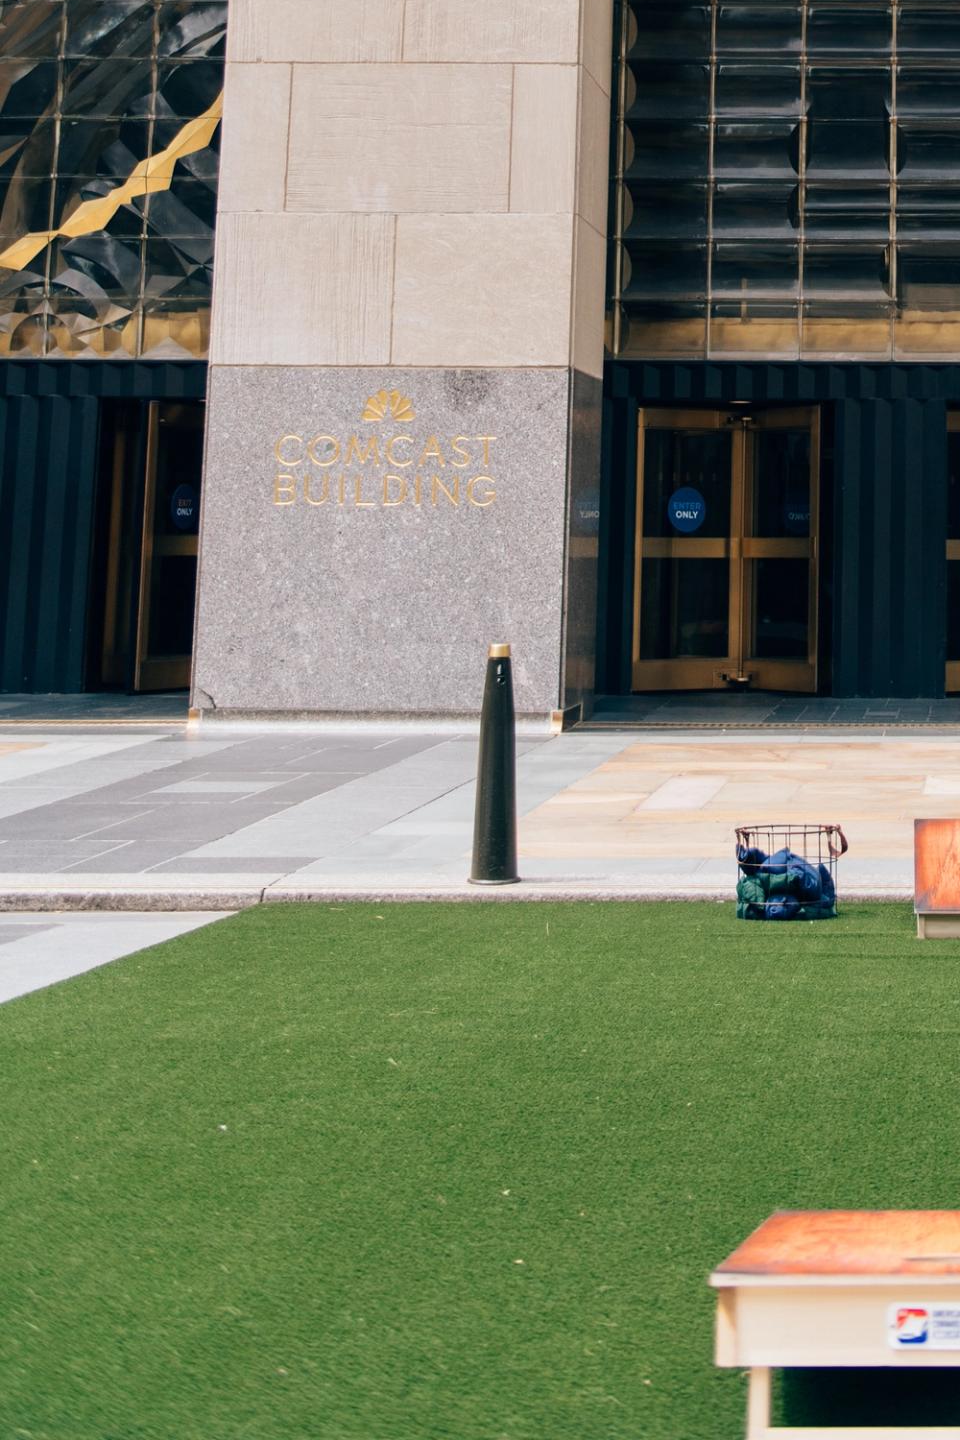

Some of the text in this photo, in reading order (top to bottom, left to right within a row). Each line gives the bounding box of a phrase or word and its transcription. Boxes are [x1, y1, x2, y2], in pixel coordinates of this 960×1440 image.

[274, 435, 497, 467] COMCAST
[273, 474, 497, 506] BUILDING
[176, 507, 193, 516] ONLY
[675, 510, 698, 519] ONLY
